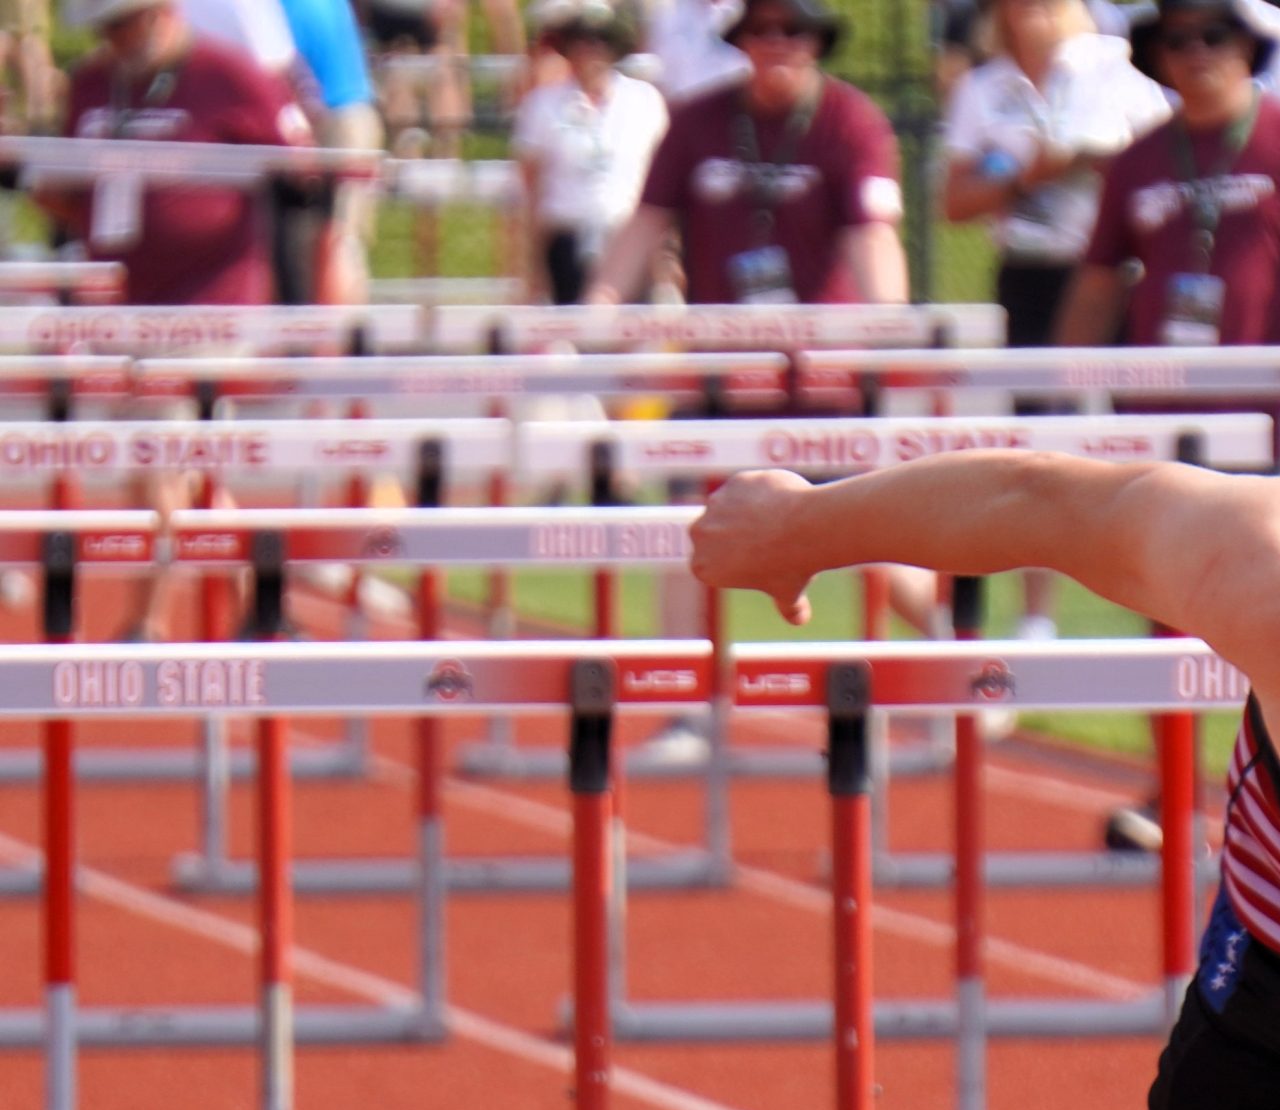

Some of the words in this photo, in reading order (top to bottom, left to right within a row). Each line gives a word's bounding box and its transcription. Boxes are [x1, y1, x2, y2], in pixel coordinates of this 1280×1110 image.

[130, 430, 268, 466] STATE
[758, 428, 882, 466] OHIO
[53, 657, 147, 707] OHIO
[156, 657, 269, 707] STATE
[626, 670, 698, 691] UCS
[741, 673, 812, 694] UCS
